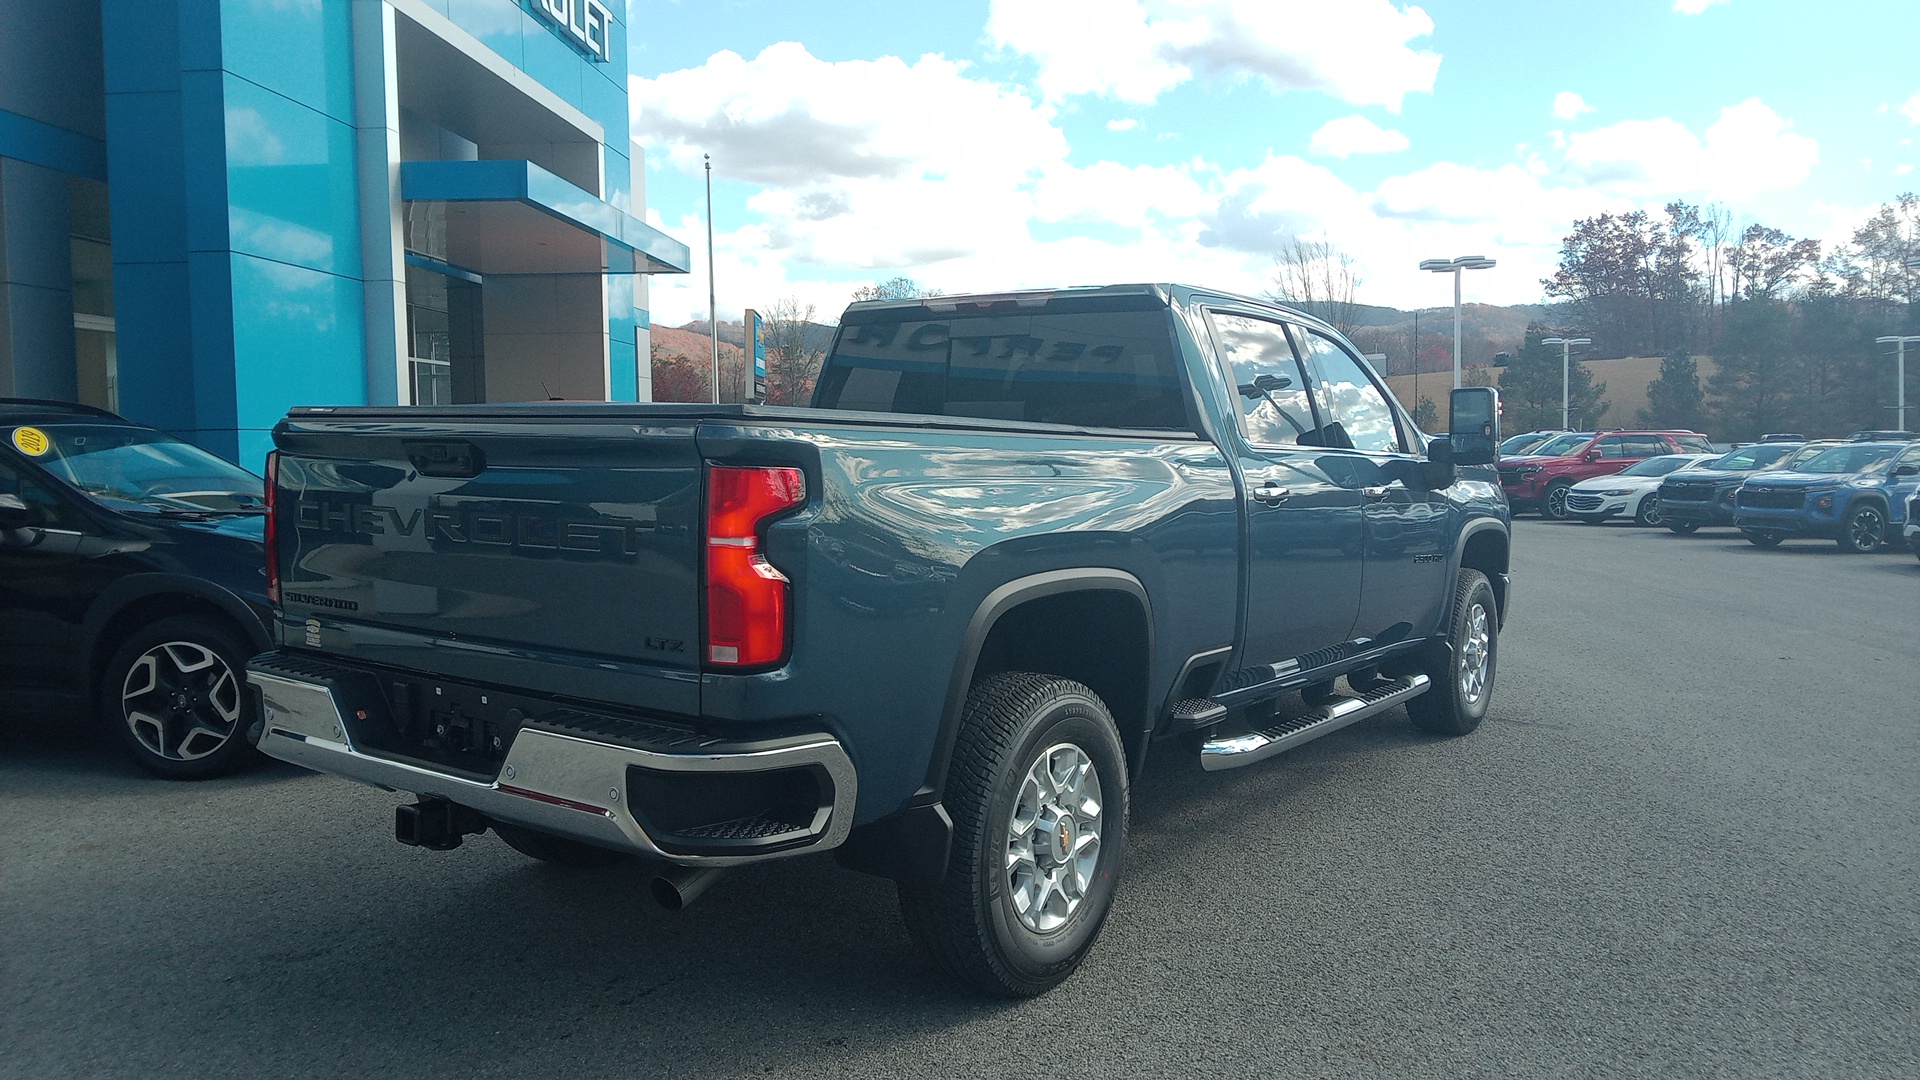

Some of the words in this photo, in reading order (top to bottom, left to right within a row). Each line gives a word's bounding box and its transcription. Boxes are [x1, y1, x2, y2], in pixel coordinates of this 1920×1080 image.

[20, 429, 41, 452] 2019
[294, 501, 656, 555] CHEVROLET
[285, 592, 359, 612] SILVERADO
[645, 636, 685, 652] LTZ
